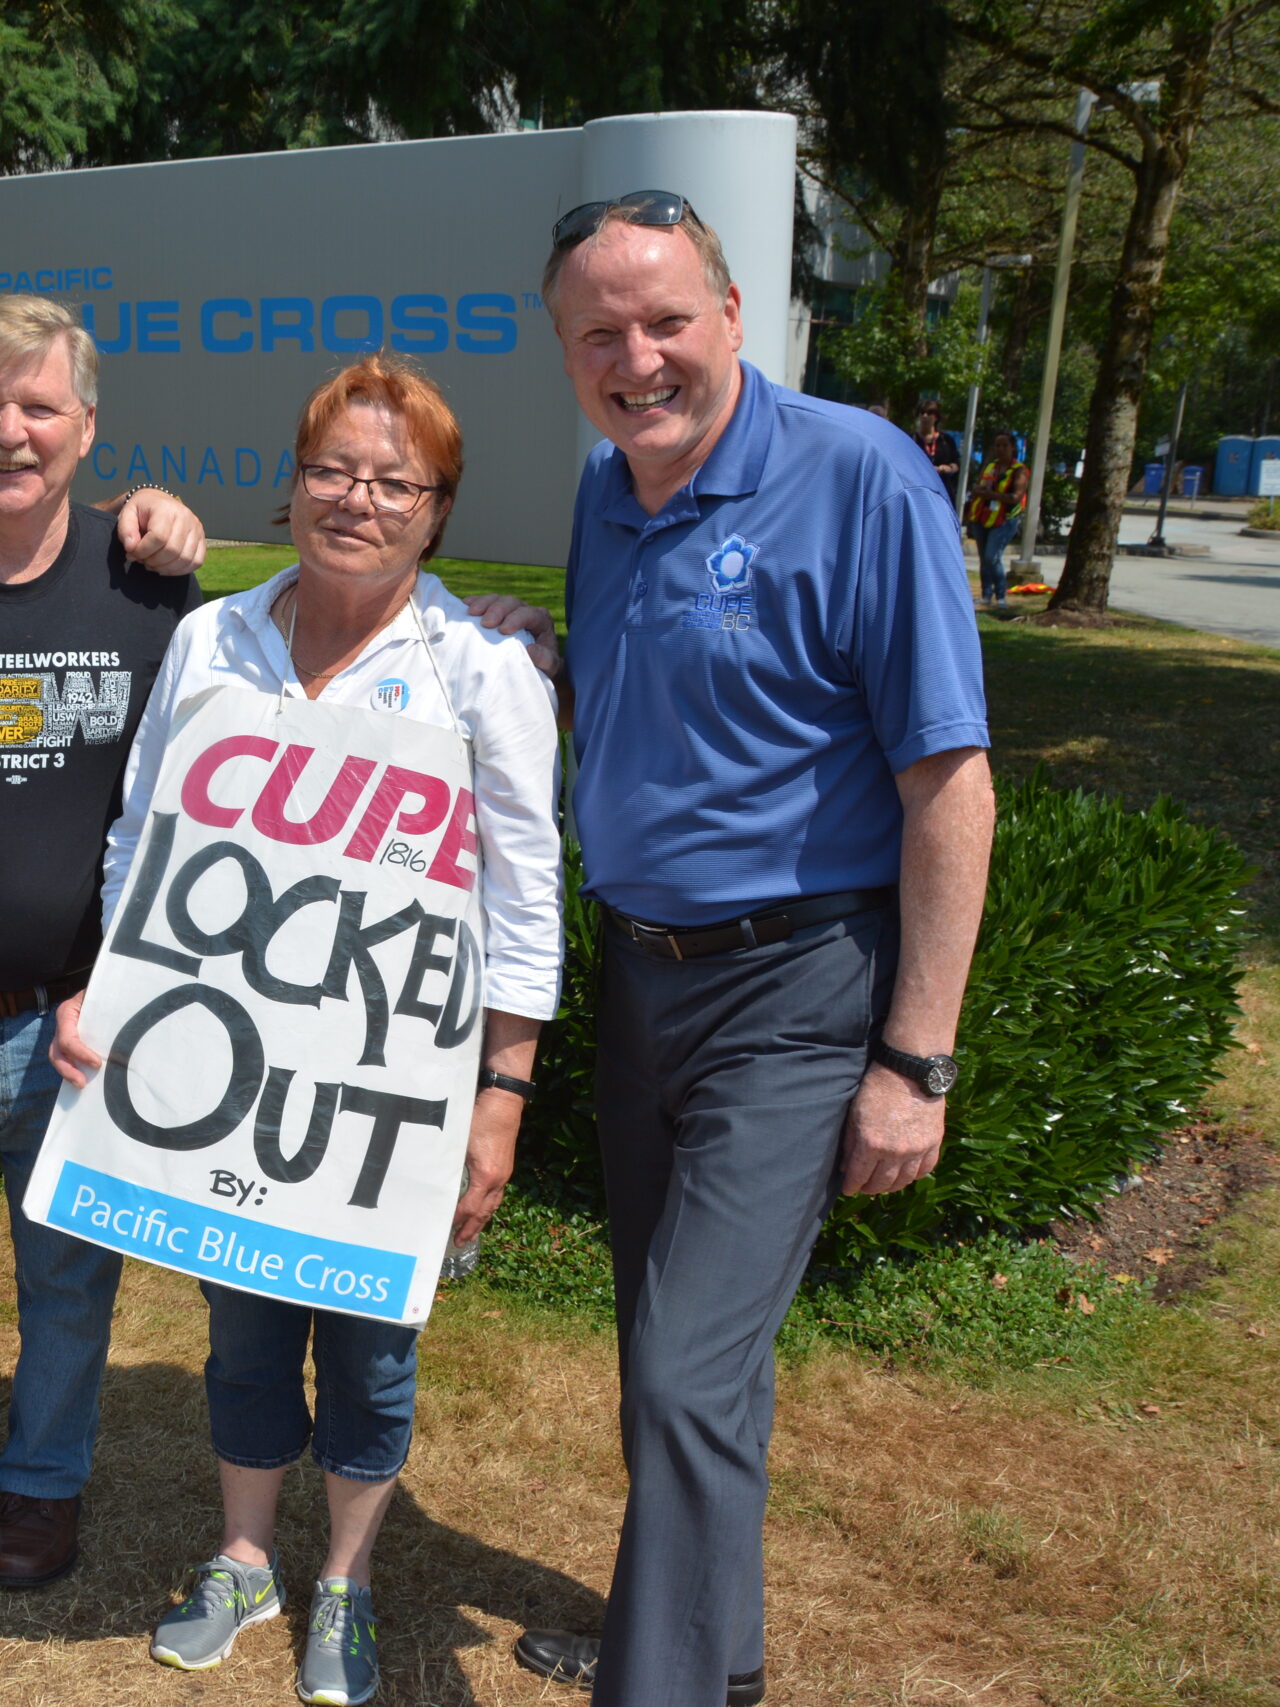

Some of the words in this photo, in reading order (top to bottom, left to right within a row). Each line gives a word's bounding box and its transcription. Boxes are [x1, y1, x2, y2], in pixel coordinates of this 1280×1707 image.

[81, 300, 182, 355] UE
[200, 293, 519, 355] CROSS
[92, 441, 297, 489] CANADA
[721, 612, 751, 631] BC
[66, 671, 91, 679] PROUD
[101, 671, 132, 679] DIVERSITY
[67, 692, 94, 704] 1942
[53, 703, 96, 711] LEADERSHIP
[53, 712, 76, 722] USW
[90, 717, 118, 726] BOLD
[36, 736, 73, 748] FIGHT
[52, 752, 66, 768] 3
[180, 734, 478, 894] CUPE
[378, 837, 427, 874] 1816
[109, 810, 481, 1067] LOCKED
[103, 982, 449, 1210] OUT
[70, 1183, 190, 1254] Pacific
[196, 1226, 285, 1281] Blue
[293, 1256, 391, 1302] Cross
